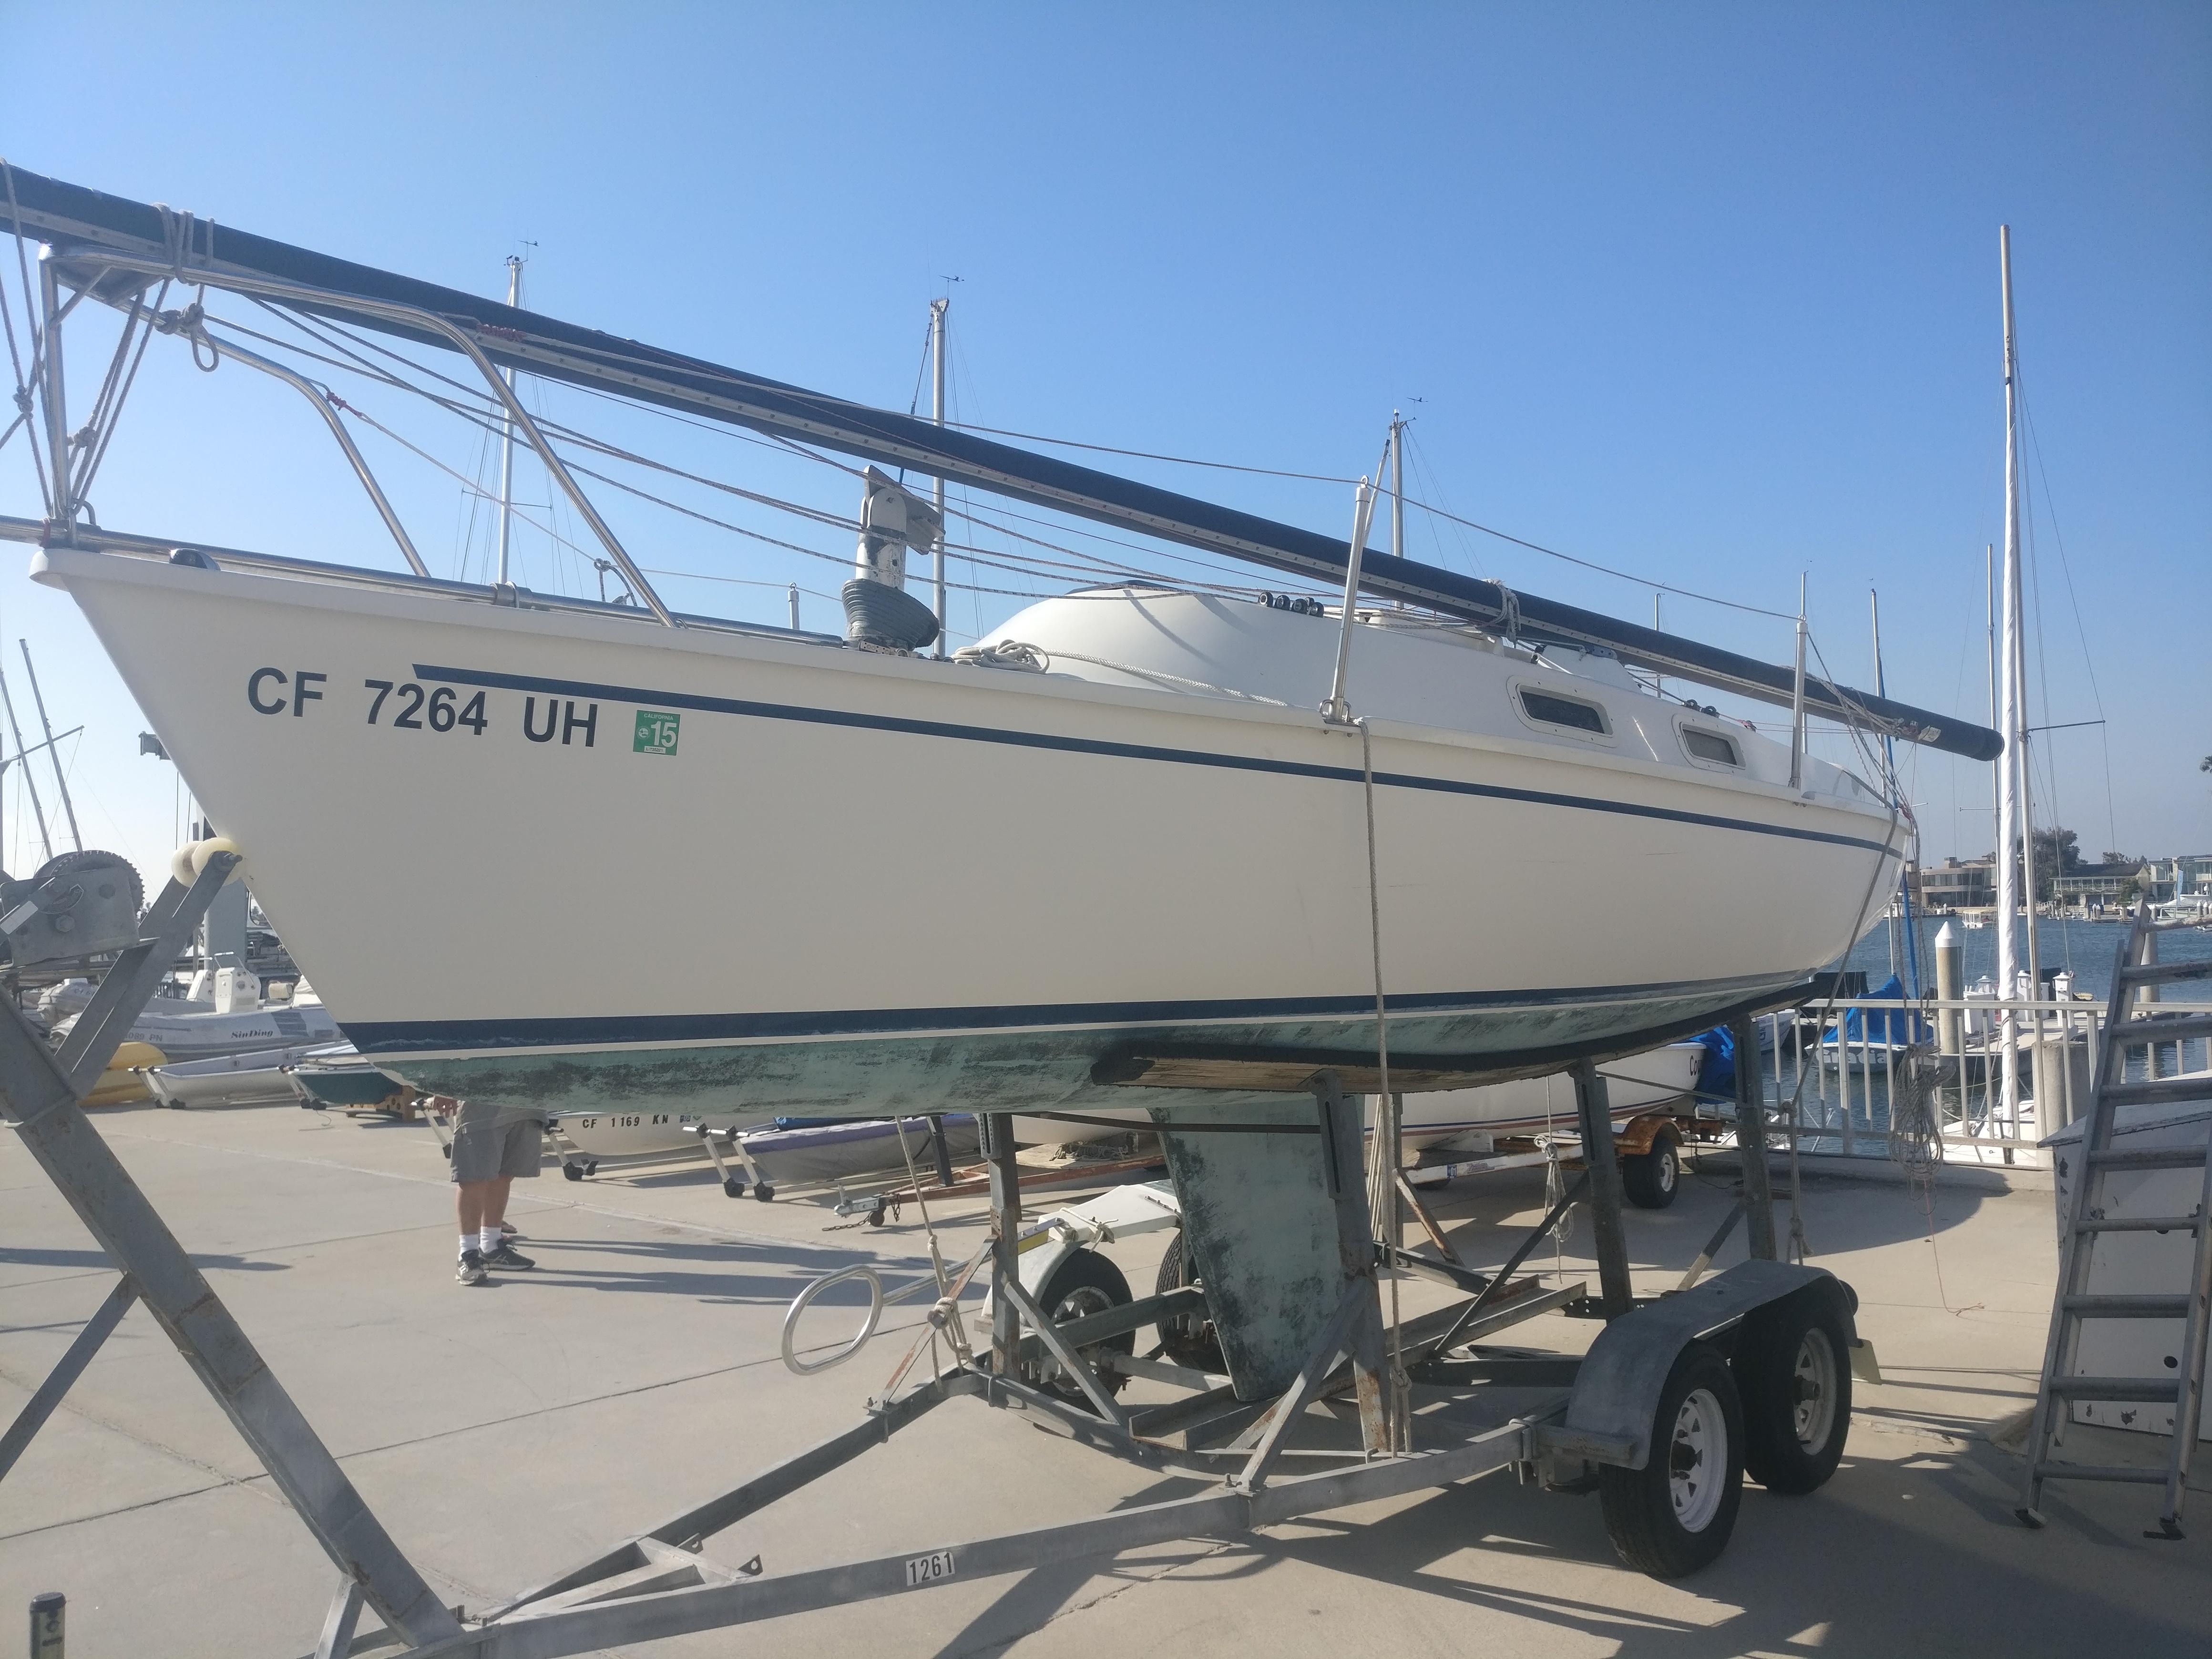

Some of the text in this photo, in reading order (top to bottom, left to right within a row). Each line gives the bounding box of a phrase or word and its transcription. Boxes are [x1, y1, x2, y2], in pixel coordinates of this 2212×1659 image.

[247, 667, 598, 748] CF 7264 UH
[651, 721, 677, 748] 15
[582, 1115, 668, 1128] CF 1169 KN
[910, 1552, 952, 1583] 1261
